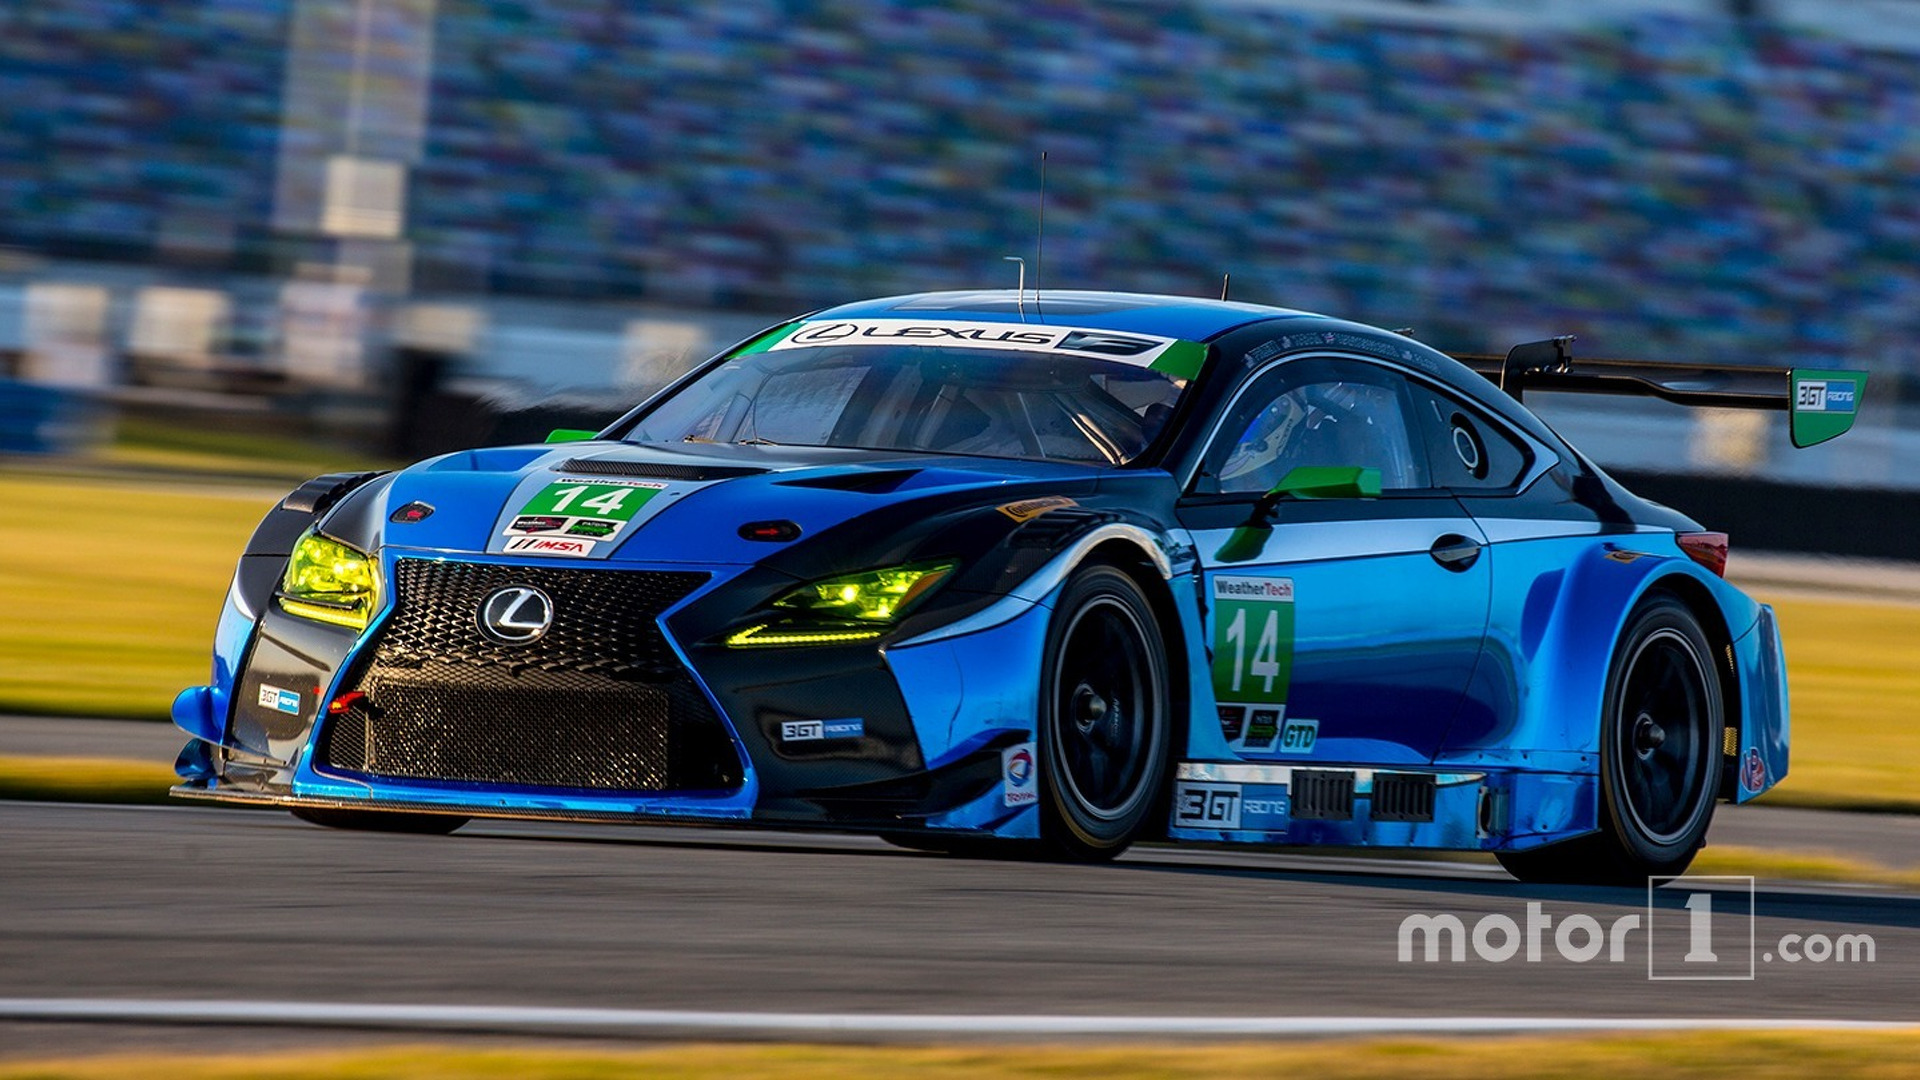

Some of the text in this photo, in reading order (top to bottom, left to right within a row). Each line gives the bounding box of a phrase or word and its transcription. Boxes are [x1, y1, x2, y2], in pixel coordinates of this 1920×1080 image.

[862, 326, 1056, 345] LEXUS
[1798, 385, 1826, 406] 3GT
[561, 478, 662, 488] WeatherTech
[551, 485, 635, 515] 14
[533, 540, 583, 552] IMSA
[1216, 579, 1291, 597] WeatherTech
[1226, 608, 1280, 693] 14
[784, 723, 822, 738] 3GT
[1283, 724, 1315, 749] GTD
[1180, 789, 1239, 821] 3GT
